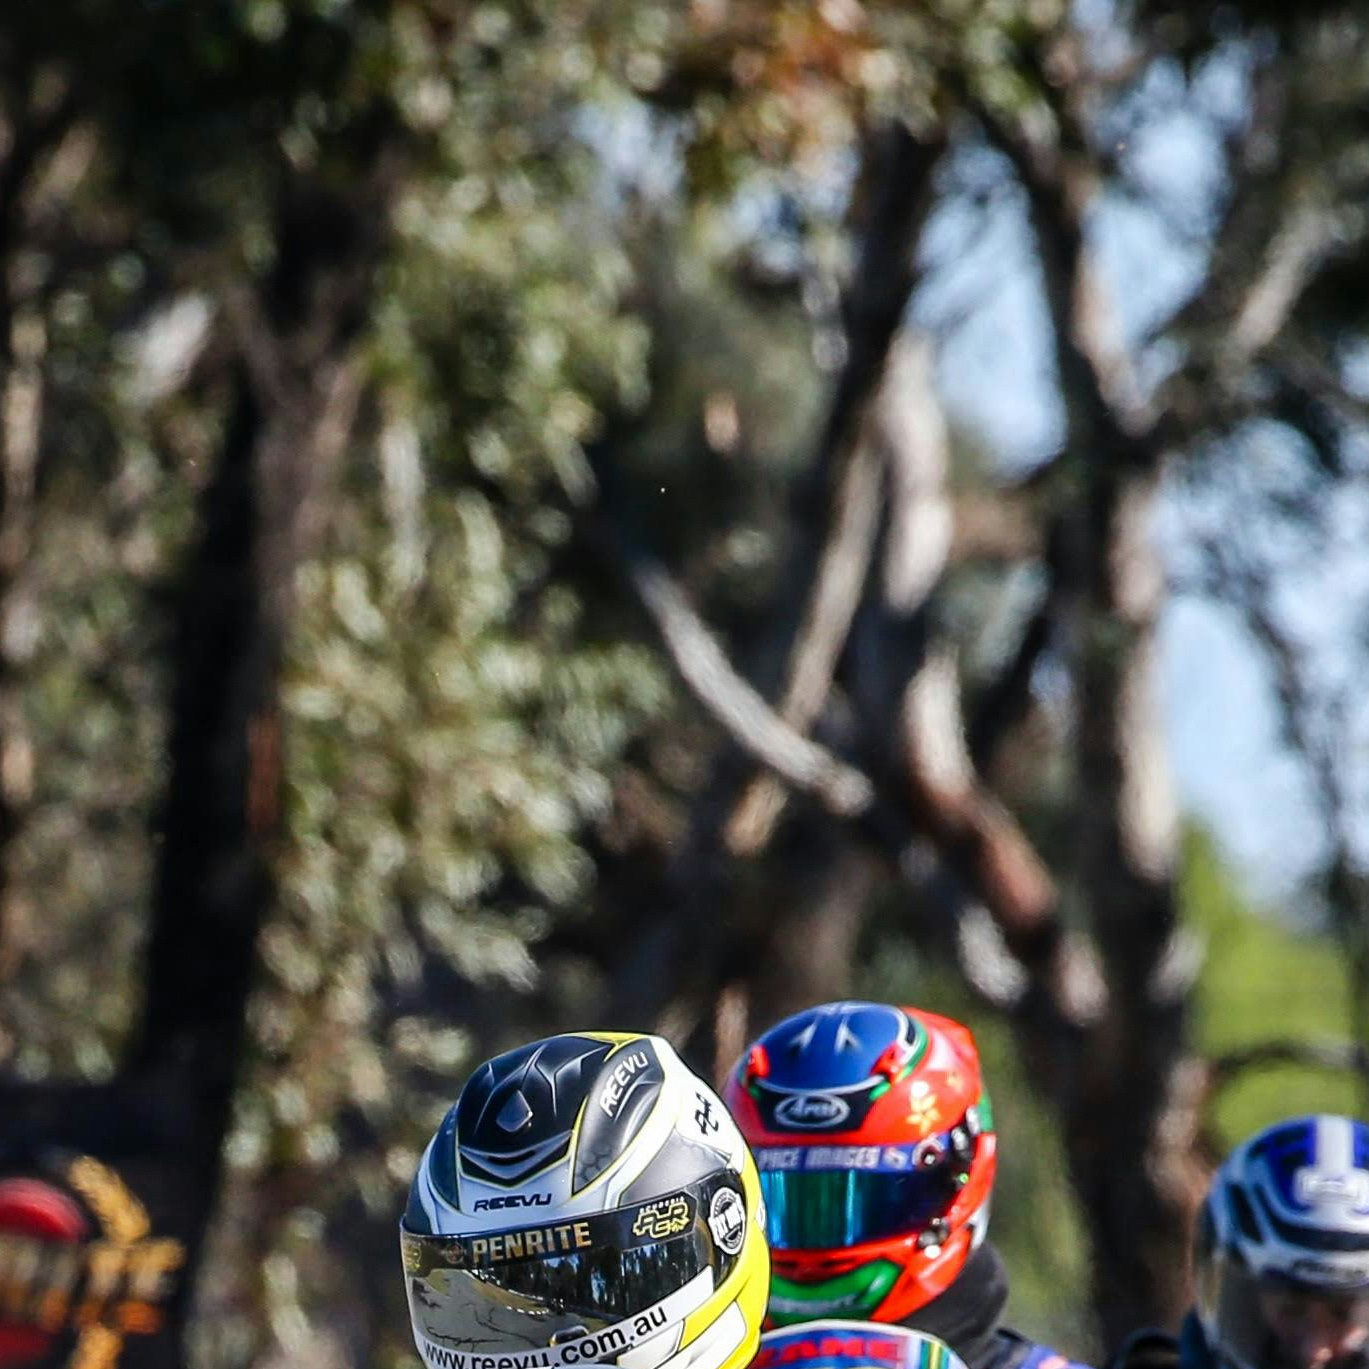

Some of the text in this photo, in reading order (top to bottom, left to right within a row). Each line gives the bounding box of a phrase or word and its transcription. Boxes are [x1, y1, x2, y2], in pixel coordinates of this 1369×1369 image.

[599, 1051, 649, 1118] REEVU
[474, 1193, 553, 1213] REEVU
[472, 1222, 592, 1264] PENRITE
